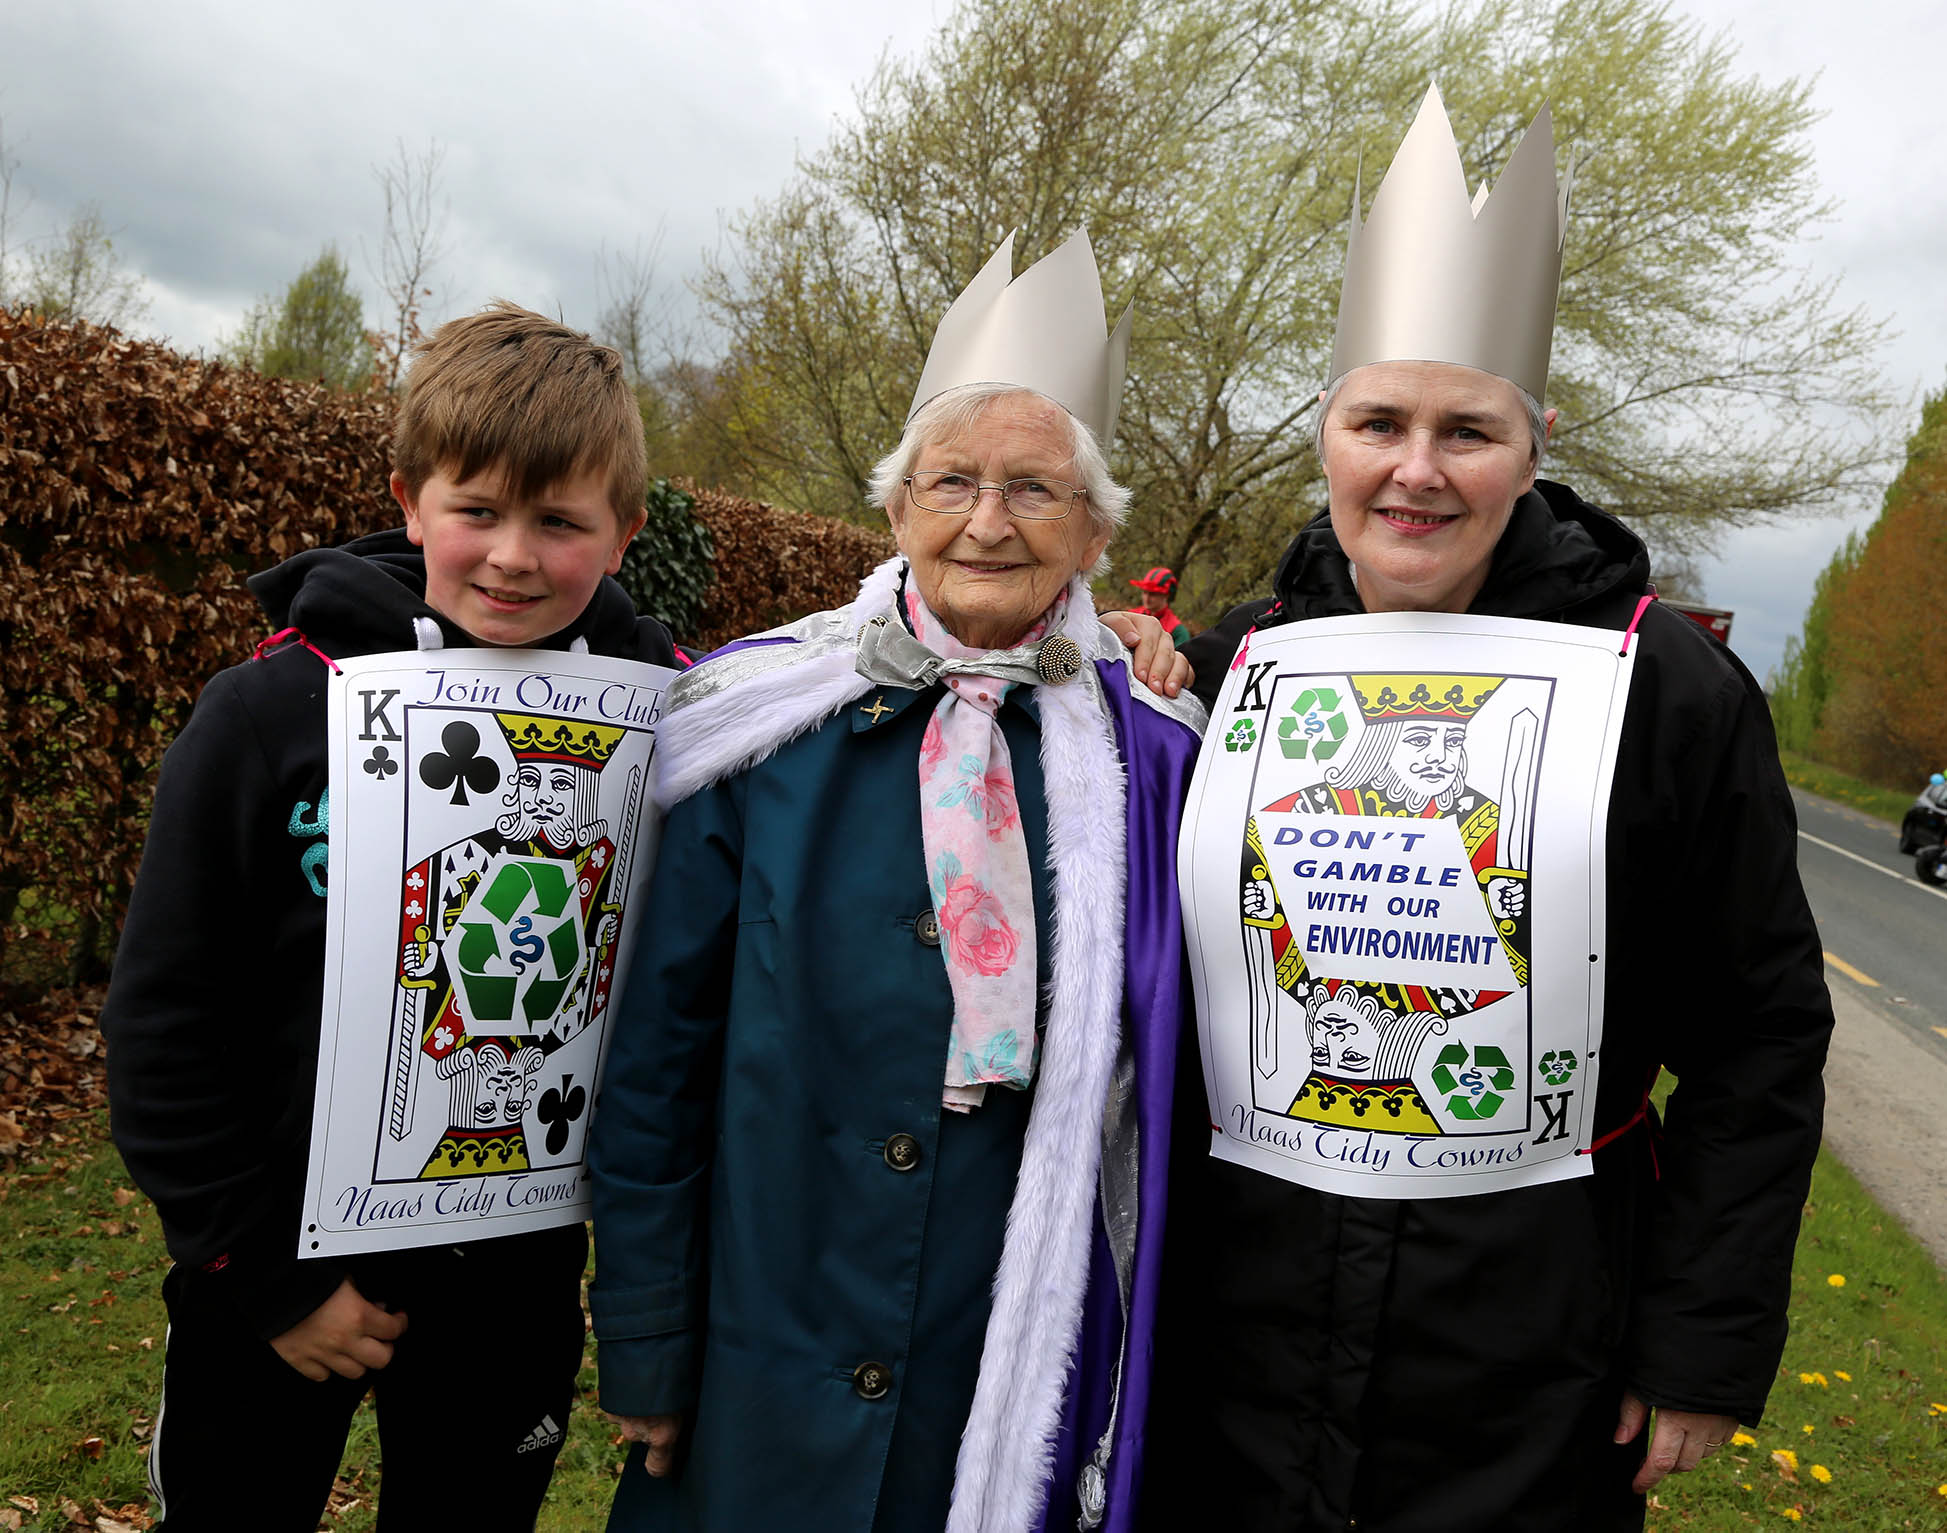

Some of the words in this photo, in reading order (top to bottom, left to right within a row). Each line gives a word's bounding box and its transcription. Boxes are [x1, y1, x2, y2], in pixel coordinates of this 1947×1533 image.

[416, 670, 500, 705] Join
[516, 673, 587, 713] Our
[598, 685, 660, 725] Club
[1234, 661, 1277, 712] K
[358, 690, 402, 741] K
[1273, 827, 1425, 852] DON'T
[1293, 860, 1462, 887] GAMBLE
[1307, 892, 1368, 914] WITH
[1388, 898, 1440, 918] OUR
[1306, 924, 1498, 965] ENVIRONMENT
[1231, 1104, 1303, 1151] Naas
[1312, 1124, 1392, 1172] Tidy
[1404, 1135, 1524, 1170] Towns
[1532, 1090, 1574, 1145] K
[335, 1186, 423, 1226] Naas
[433, 1176, 497, 1217] Tidy
[505, 1175, 577, 1209] Towns
